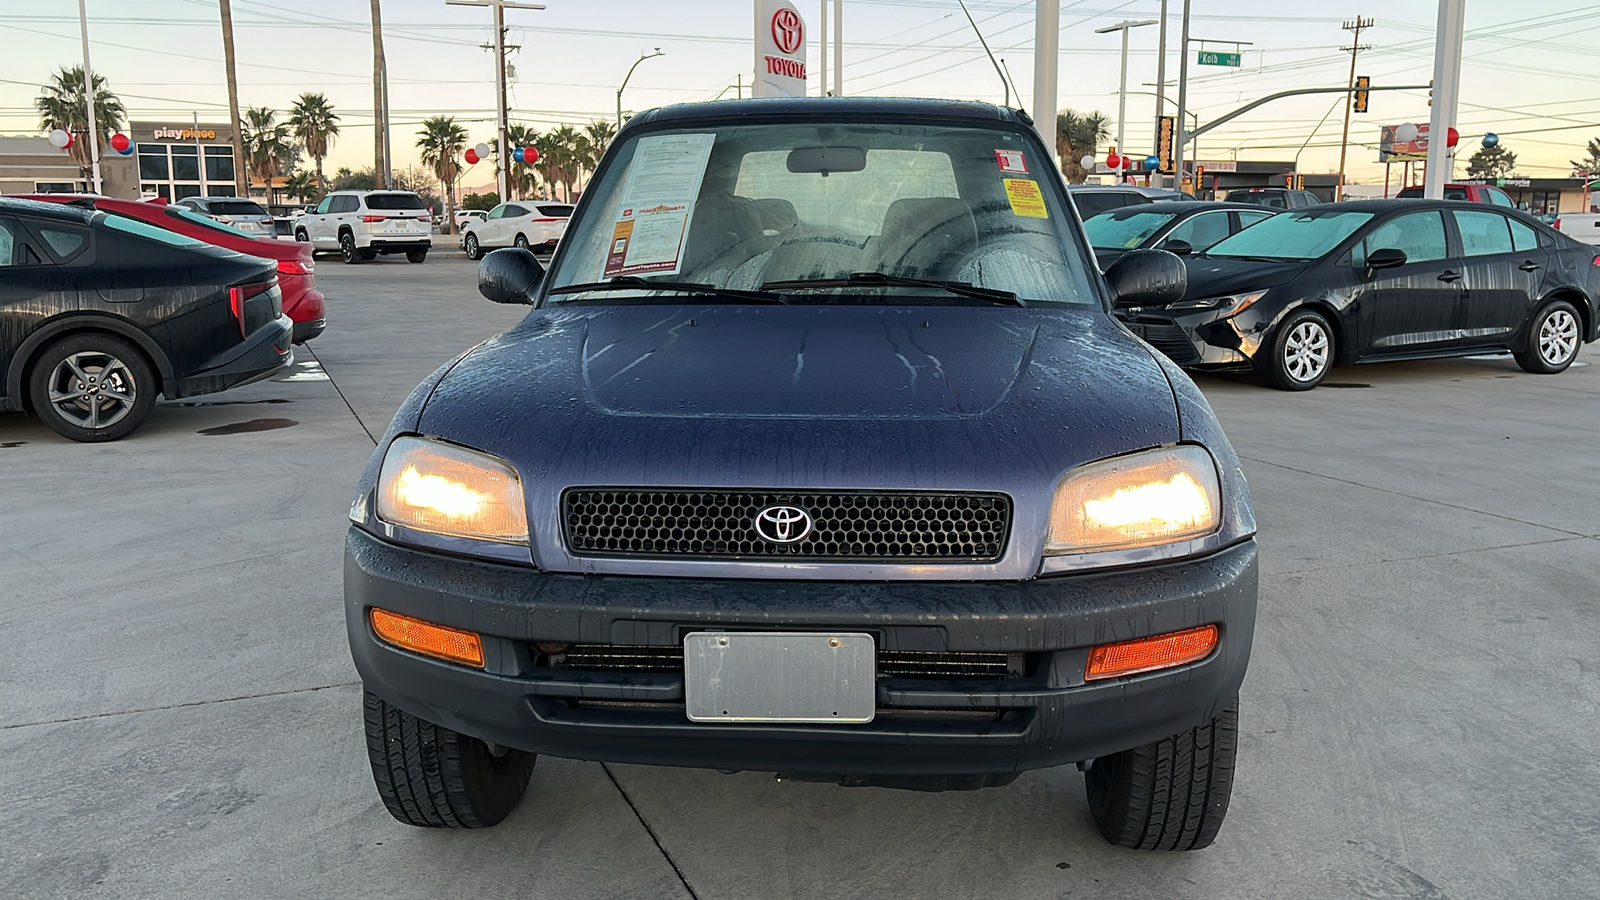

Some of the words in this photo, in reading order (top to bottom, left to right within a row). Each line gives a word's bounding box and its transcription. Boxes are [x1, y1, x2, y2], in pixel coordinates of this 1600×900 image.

[1203, 53, 1218, 63] Kolb
[764, 56, 807, 80] TOYOTA
[154, 127, 216, 140] playplace
